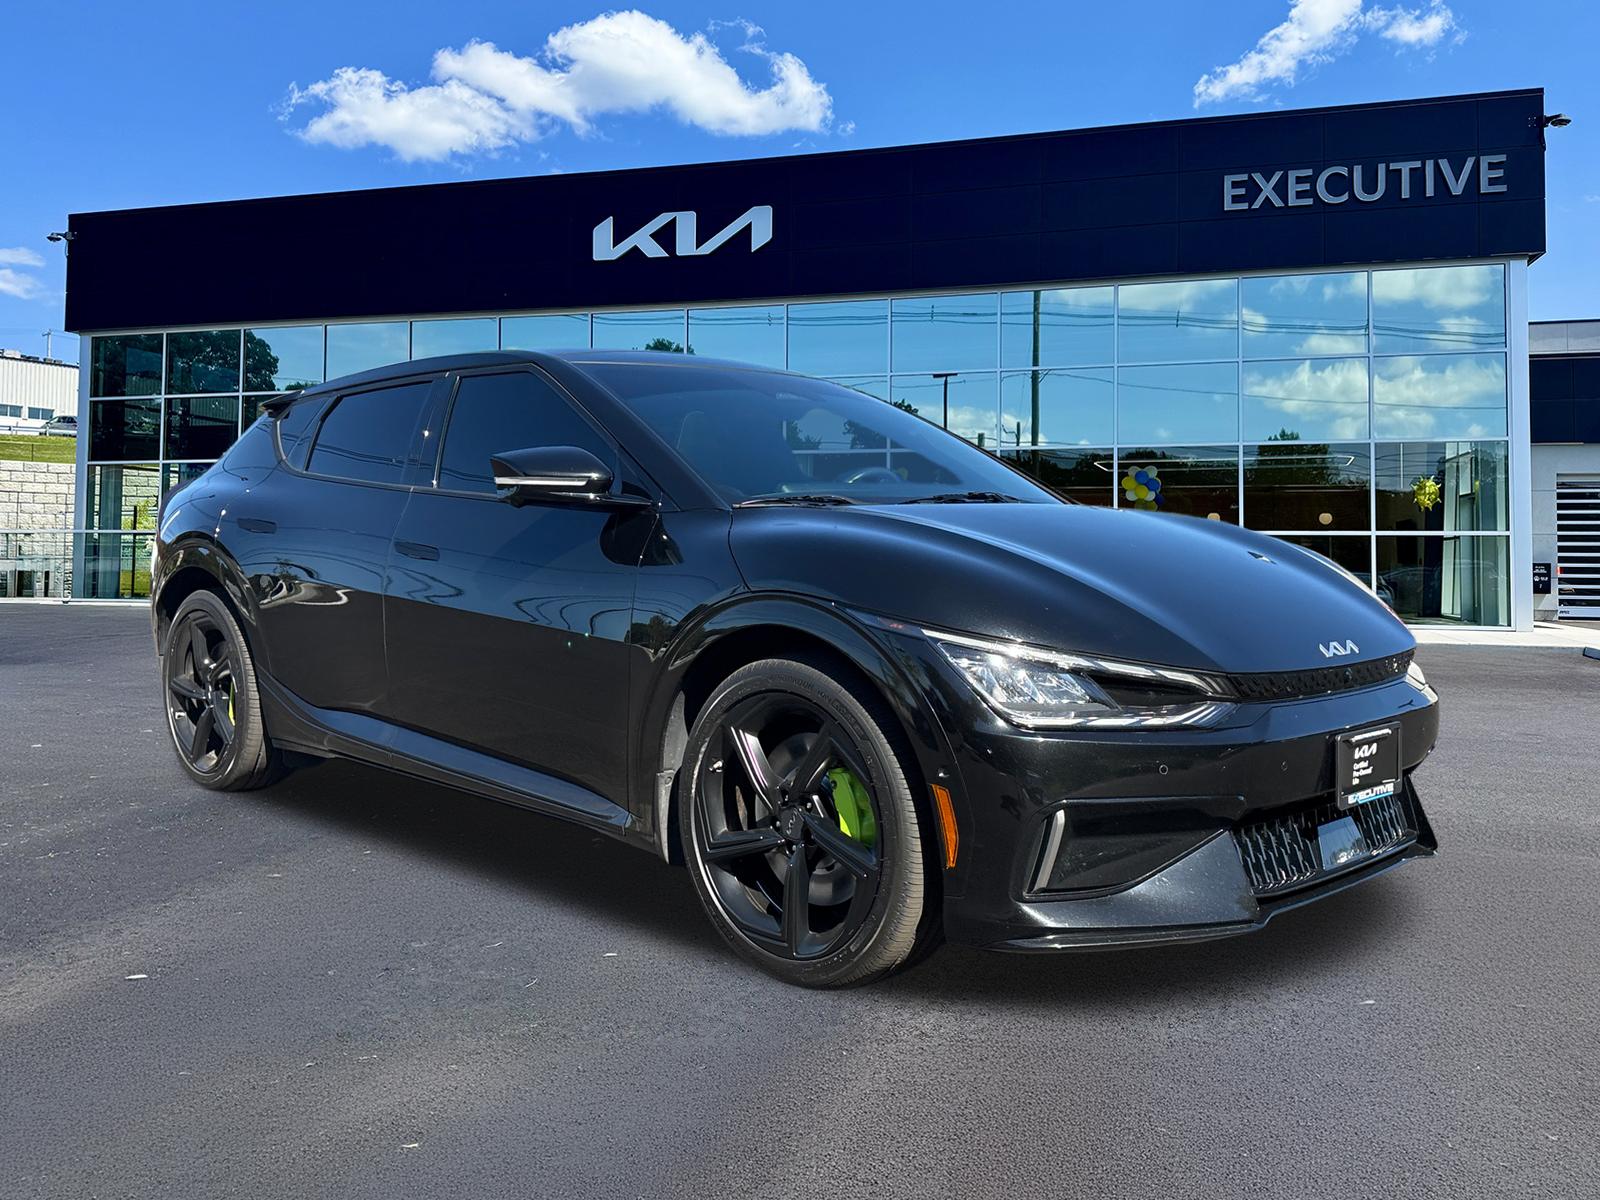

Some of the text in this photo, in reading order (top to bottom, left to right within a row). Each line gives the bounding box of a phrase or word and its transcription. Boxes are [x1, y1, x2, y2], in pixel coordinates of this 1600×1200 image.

[1223, 154, 1508, 211] EXECUTIVE
[593, 205, 773, 261] KIA
[1319, 640, 1360, 658] KIA
[1354, 743, 1377, 759] KIA
[1348, 784, 1394, 804] EXECUTIVE
